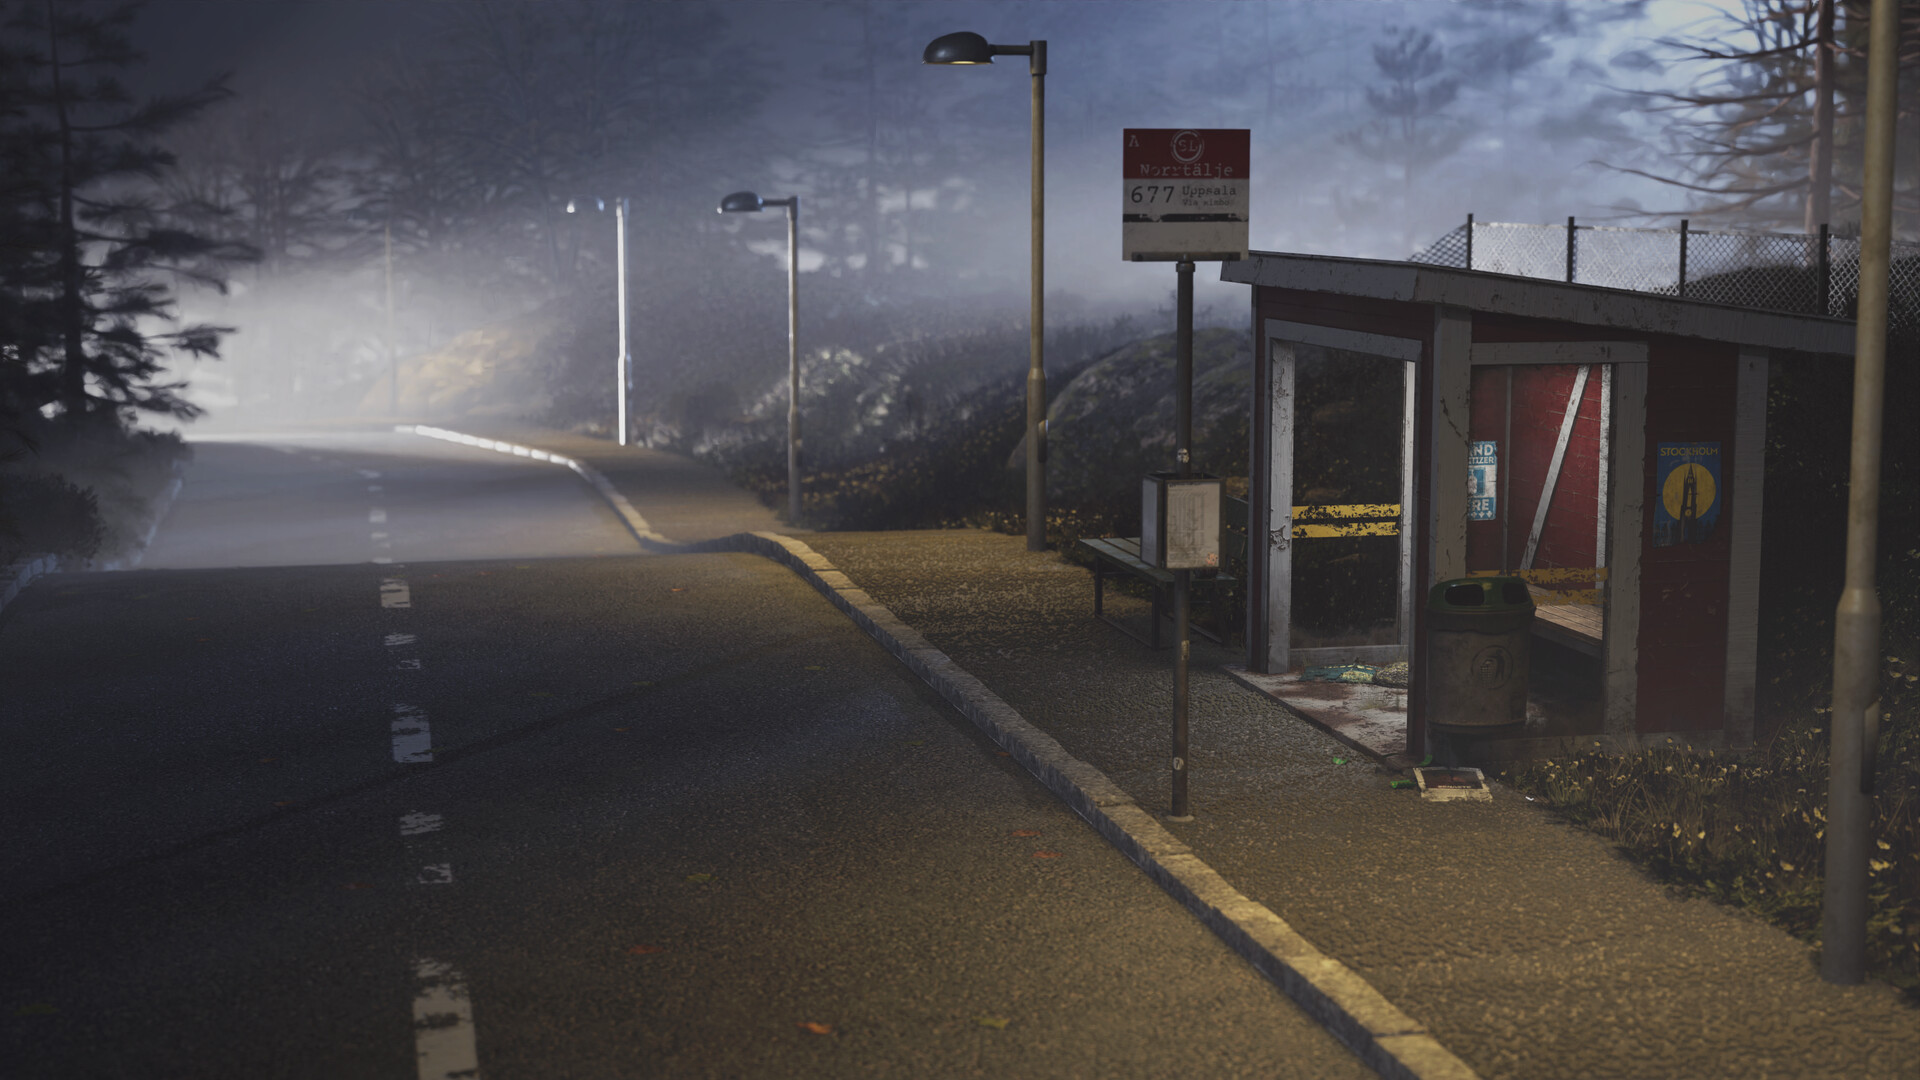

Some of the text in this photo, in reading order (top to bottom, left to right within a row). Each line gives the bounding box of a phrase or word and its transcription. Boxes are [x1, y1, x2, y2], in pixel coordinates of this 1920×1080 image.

[1131, 186, 1175, 203] 677
[1182, 185, 1237, 198] Uppsala
[1469, 444, 1494, 456] ND
[1660, 447, 1719, 456] STOCKHOLM
[1469, 499, 1490, 511] RE
